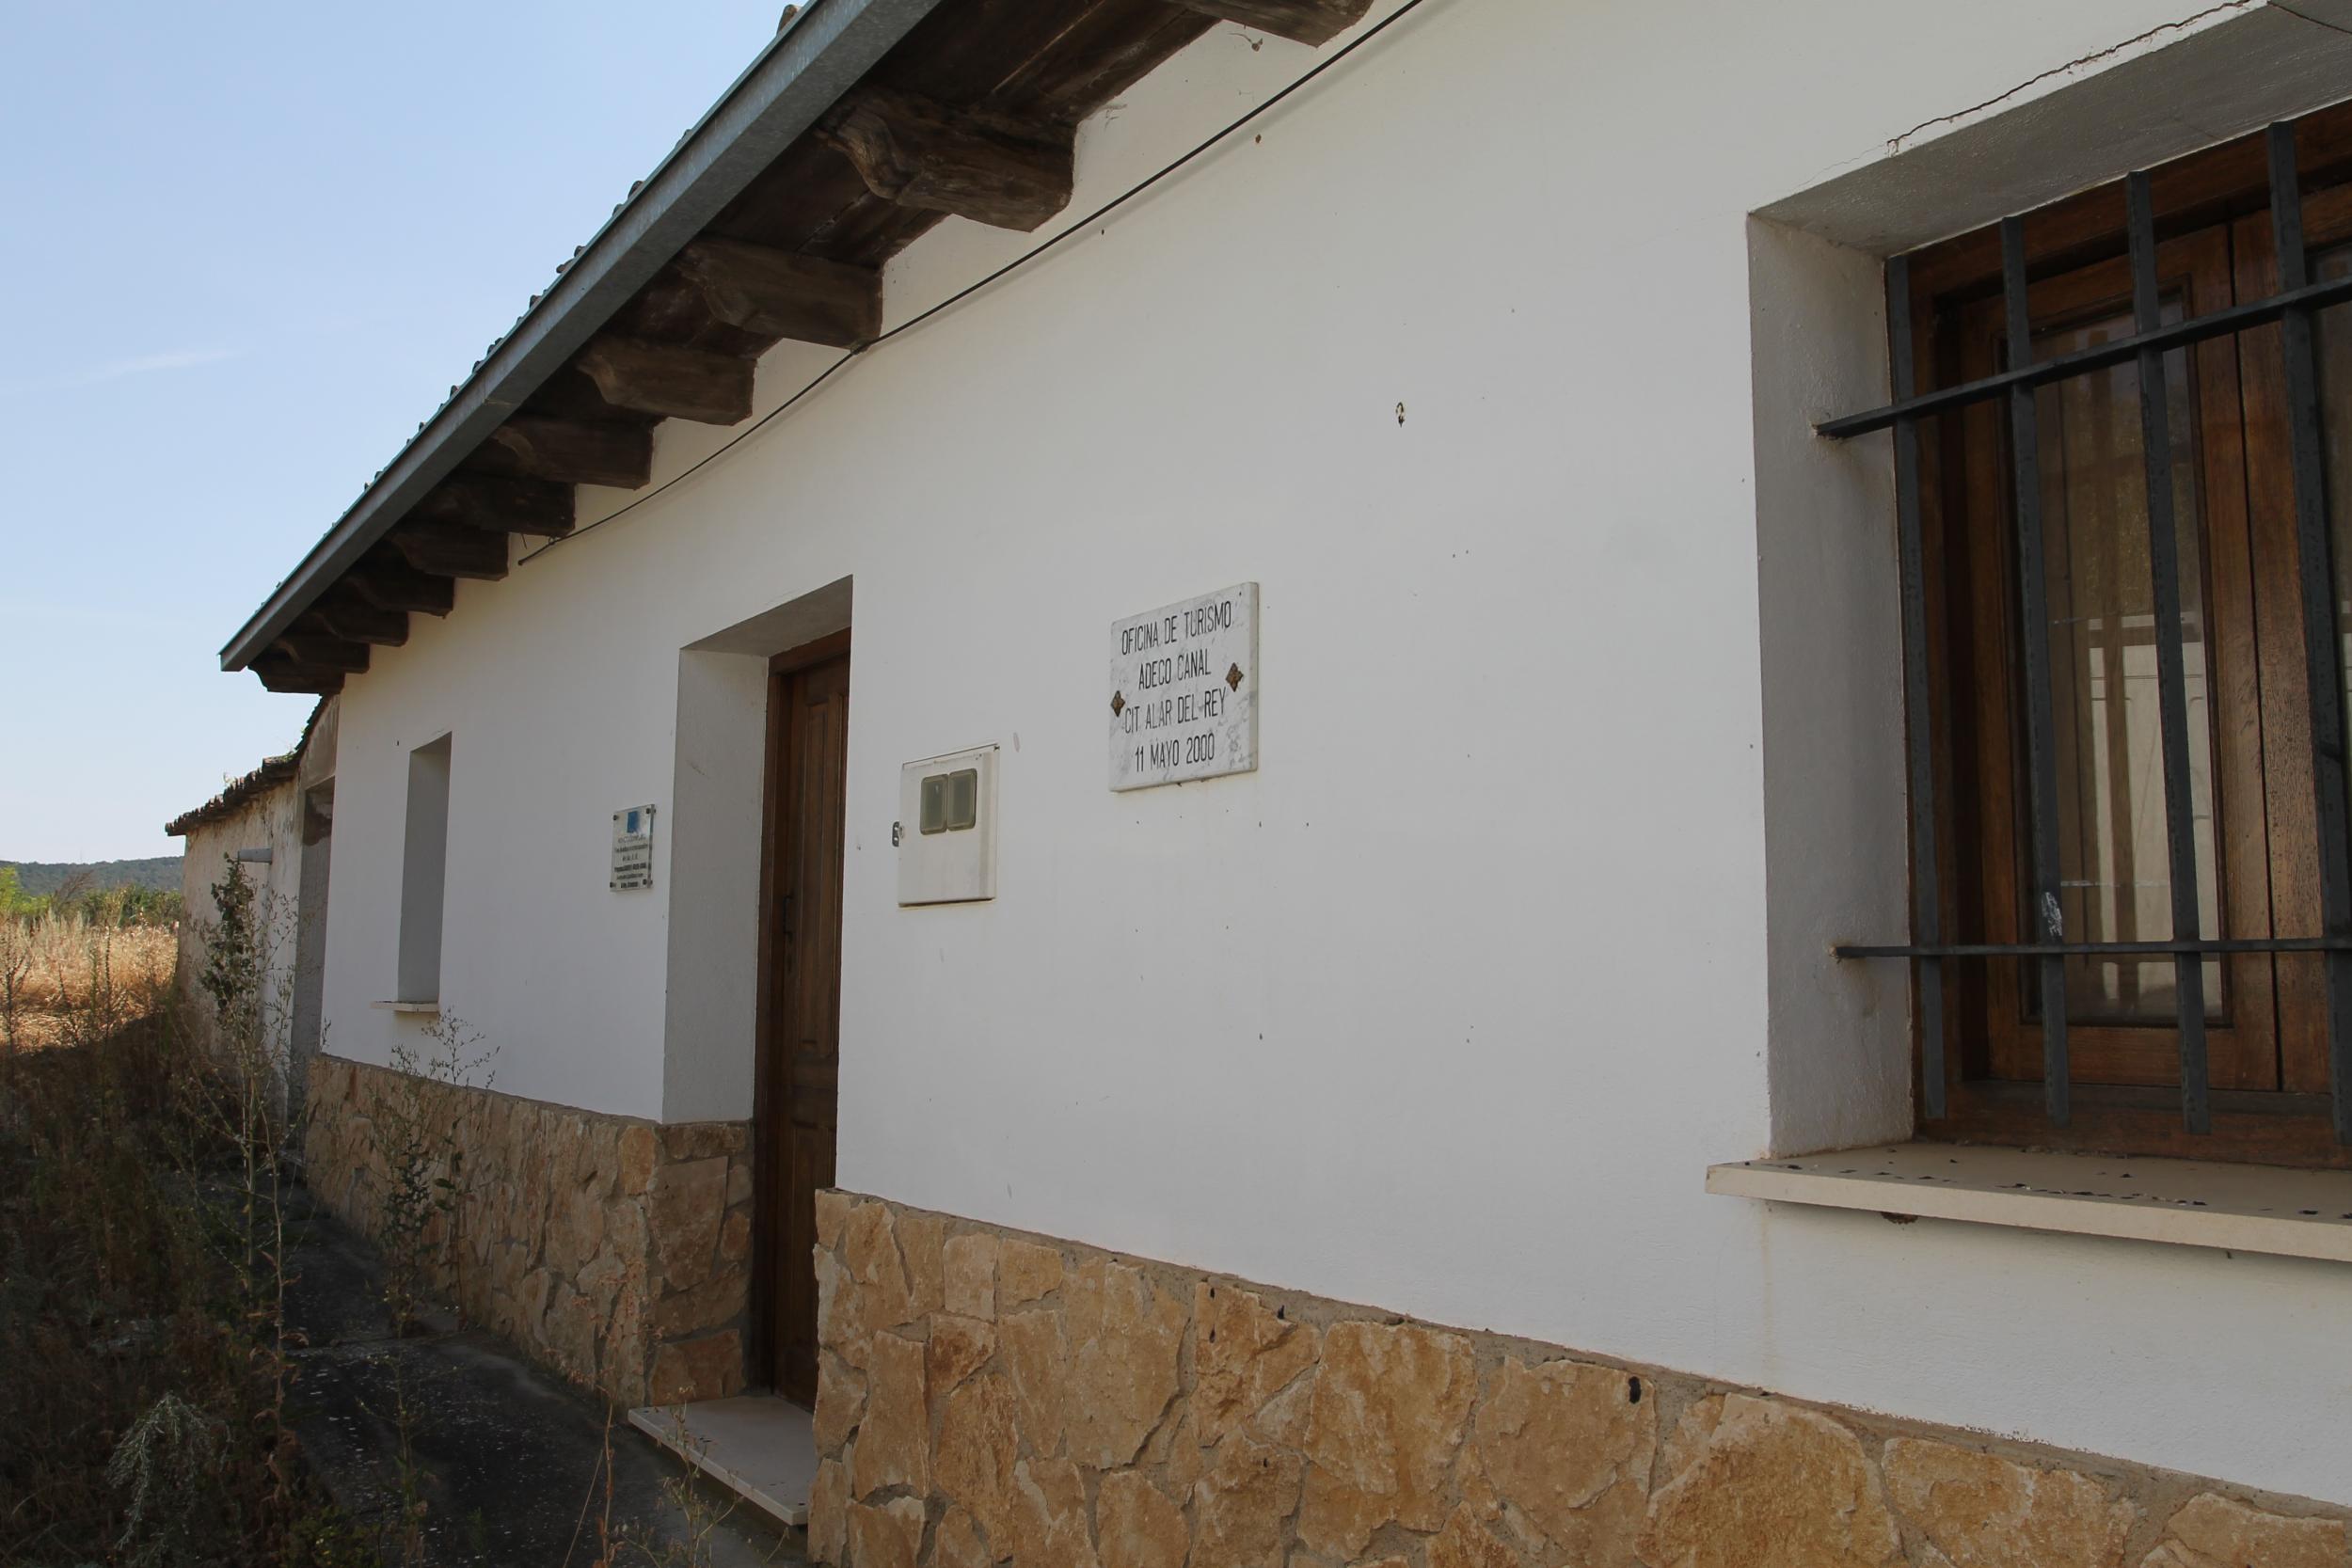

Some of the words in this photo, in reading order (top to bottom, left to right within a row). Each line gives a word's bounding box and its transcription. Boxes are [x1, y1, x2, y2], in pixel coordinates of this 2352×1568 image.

[1122, 622, 1158, 655] OFICINA
[1165, 615, 1177, 643] DE
[1184, 601, 1232, 640] TURISMO
[1138, 658, 1171, 690] ADECO
[1178, 649, 1211, 681] CANAL
[1125, 706, 1139, 734] CIT
[1146, 700, 1171, 730] ALAR
[1178, 694, 1198, 724] DEL
[1204, 687, 1226, 719] REY
[1136, 746, 1144, 772] 11
[1151, 739, 1180, 768] MAYO
[1186, 733, 1215, 764] 2000
